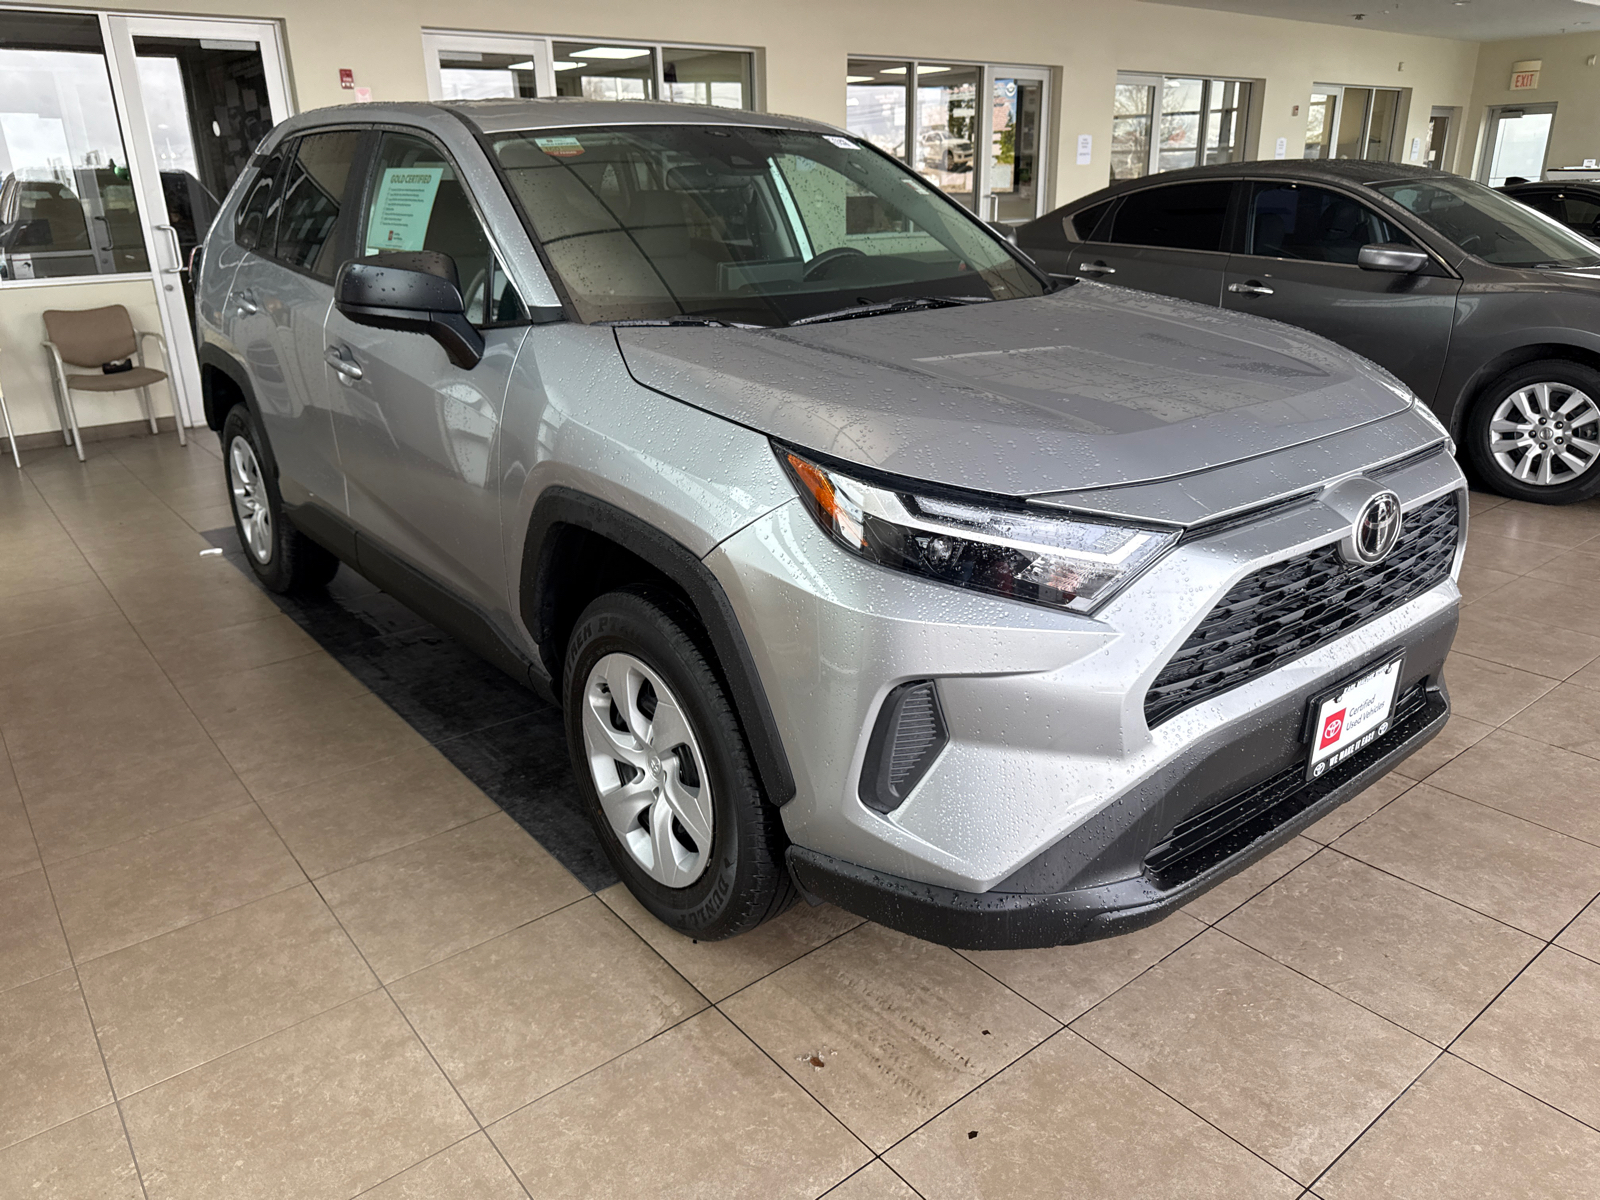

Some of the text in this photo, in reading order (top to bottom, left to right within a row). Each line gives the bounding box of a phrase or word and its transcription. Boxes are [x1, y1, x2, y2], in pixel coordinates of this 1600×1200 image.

[1515, 74, 1535, 88] EXIT
[390, 174, 432, 184] GOLD CERTIFIED
[1346, 700, 1384, 731] Used Vehicles
[1349, 694, 1377, 717] Certified
[1329, 731, 1375, 766] WE MAKE IT EASY
